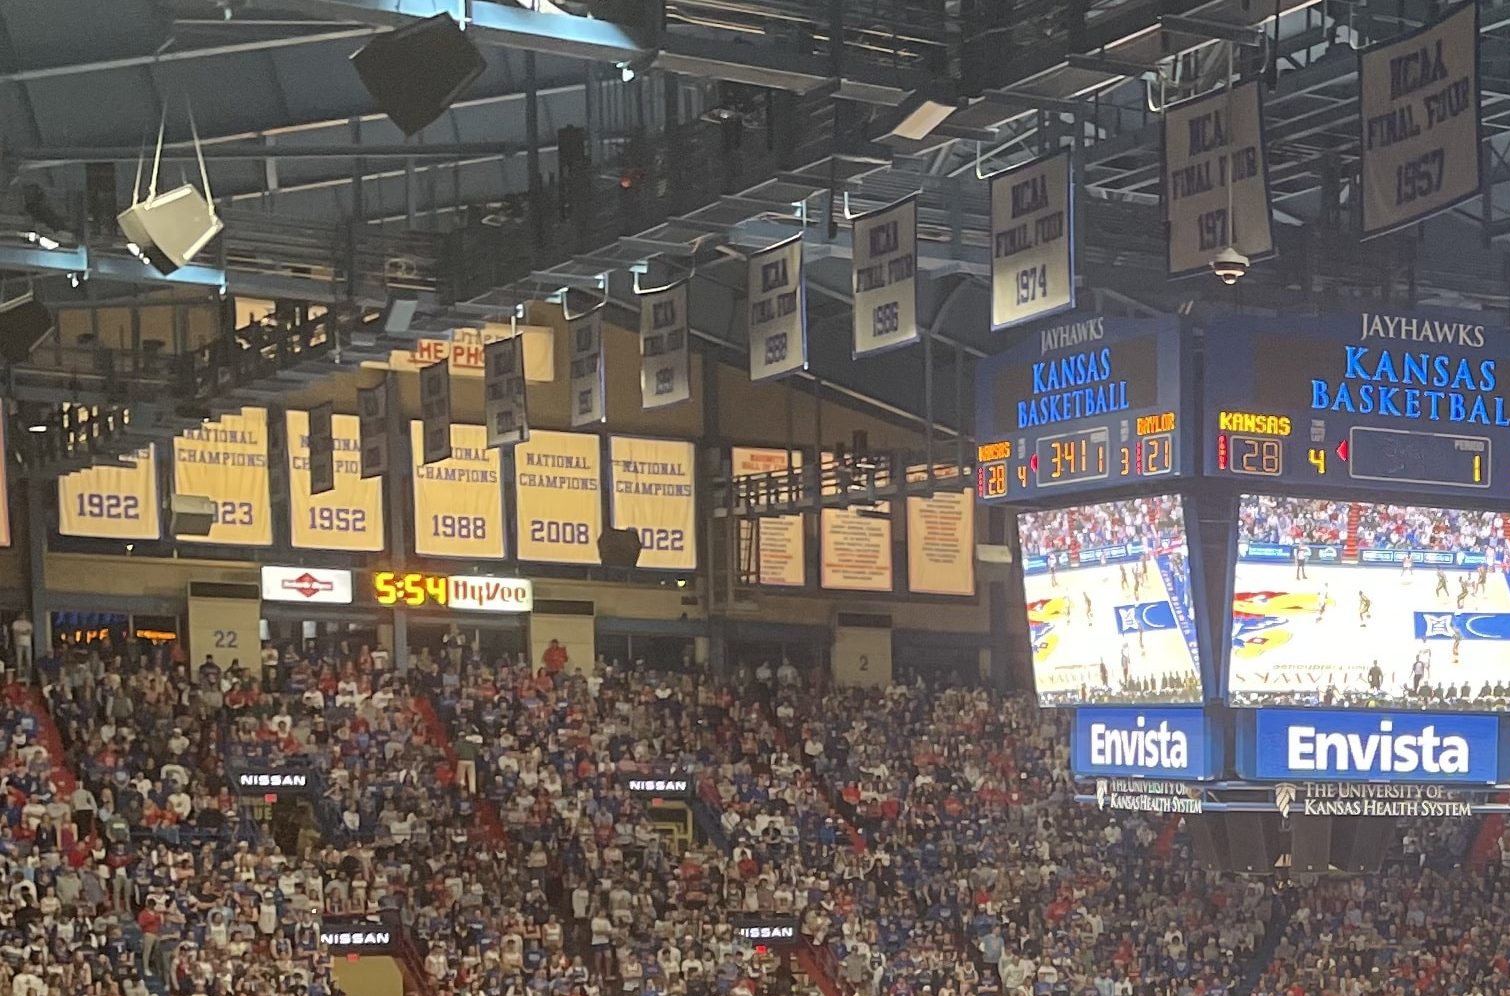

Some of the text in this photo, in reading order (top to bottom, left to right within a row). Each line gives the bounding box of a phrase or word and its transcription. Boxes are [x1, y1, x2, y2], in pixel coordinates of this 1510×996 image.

[1396, 149, 1445, 205] 1957
[1016, 264, 1047, 306] 1974
[1041, 316, 1104, 355] JAYHAWKS
[1360, 313, 1485, 348] JAYHAWKS
[1032, 347, 1112, 394] KANSAS
[1345, 345, 1496, 392] KANSAS
[1017, 381, 1130, 429] BASKETBALL
[1219, 411, 1292, 436] KANSAS
[185, 428, 258, 445] NATIONAL
[177, 448, 266, 468] CHAMPIONS
[526, 453, 591, 470] NATIONAL
[1120, 447, 1130, 476] 3
[1242, 440, 1279, 472] 28
[1308, 448, 1326, 474] 4
[1473, 455, 1481, 482] 1
[416, 465, 498, 484] CHAMPIONS
[622, 461, 686, 477] NATIONAL
[1017, 465, 1028, 488] 4
[518, 473, 598, 491] CHAMPIONS
[615, 480, 692, 497] CHAMPIONS
[77, 492, 140, 520] 1922
[308, 507, 367, 532] 1952
[432, 514, 487, 540] 1988
[531, 520, 589, 545] 2008
[375, 571, 448, 606] 5:54
[214, 630, 238, 648] 22
[859, 655, 869, 671] 2
[1090, 715, 1188, 769] Envista
[1287, 720, 1470, 774] Envista
[240, 774, 307, 786] NISSAN
[629, 780, 687, 791] NISSAN
[1304, 781, 1446, 800] THE UNIVERSITY OF
[1110, 794, 1203, 815] KANSAS HEALTH SYSTEM
[1304, 800, 1473, 817] KANSAS HEALTH SYSTEM
[320, 932, 390, 945] NISSAN
